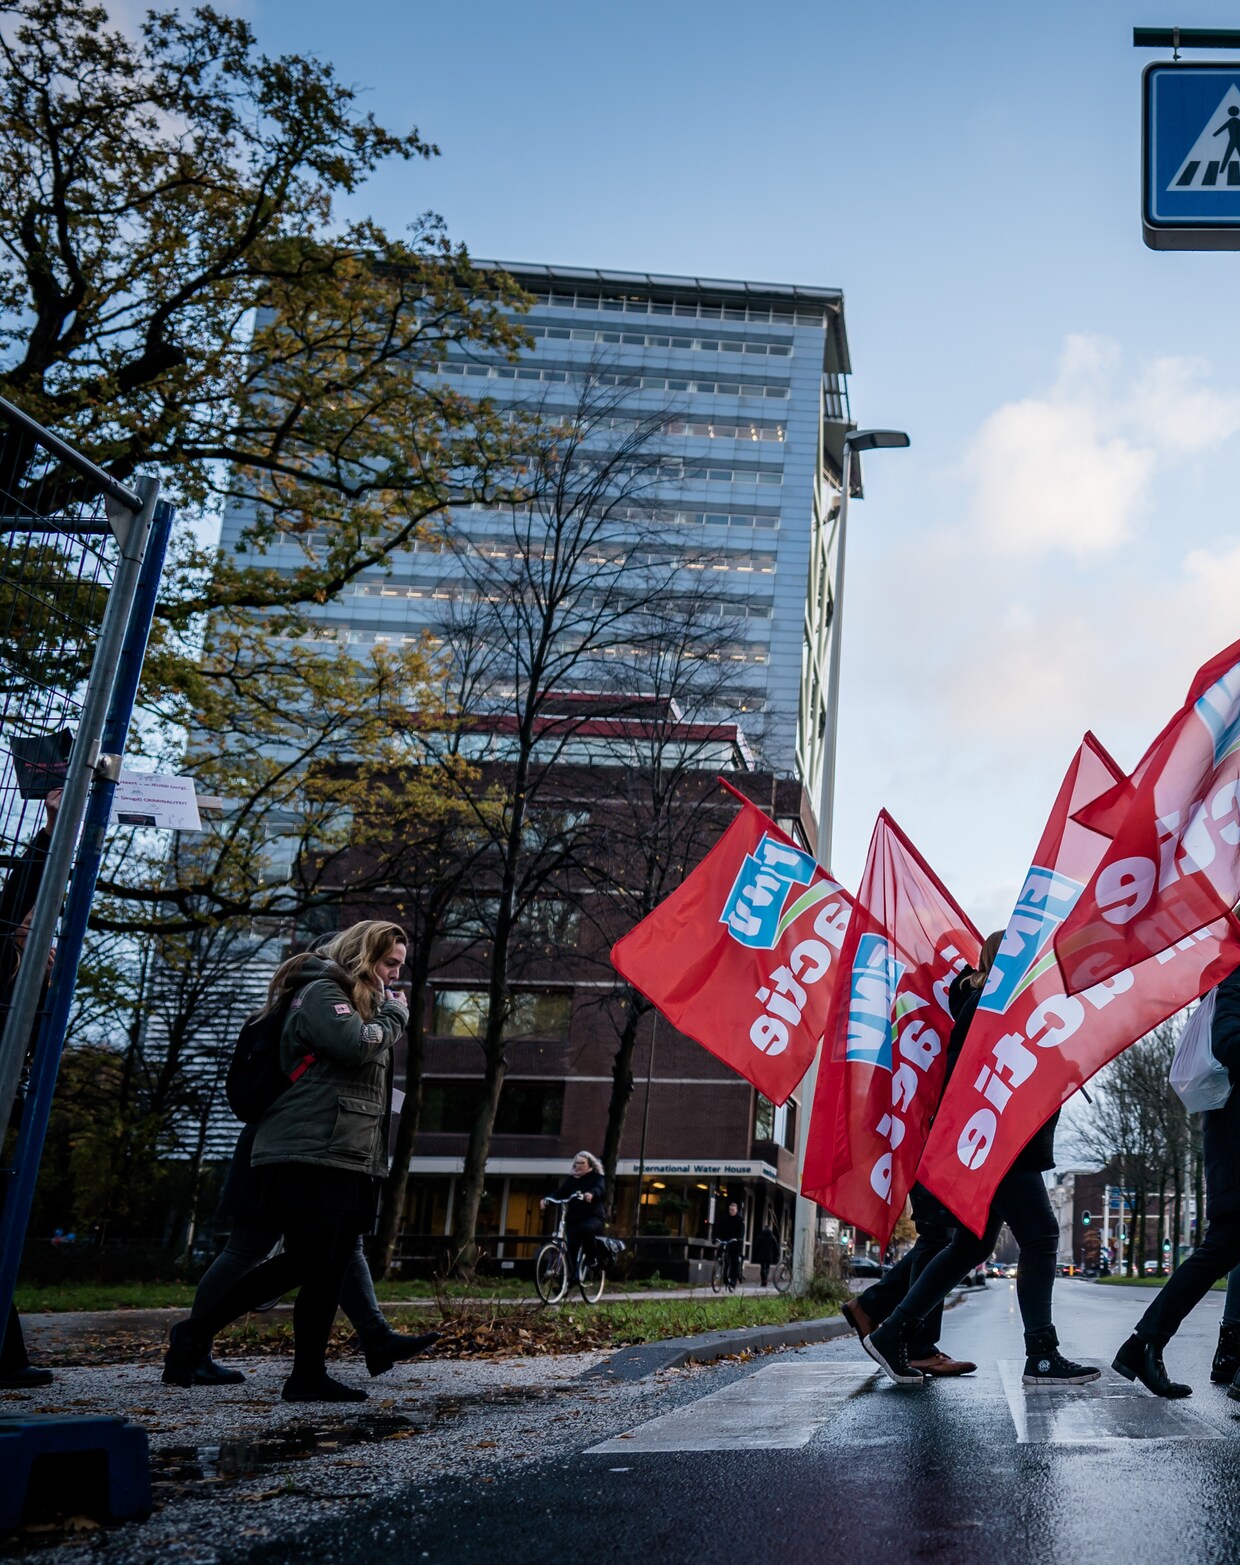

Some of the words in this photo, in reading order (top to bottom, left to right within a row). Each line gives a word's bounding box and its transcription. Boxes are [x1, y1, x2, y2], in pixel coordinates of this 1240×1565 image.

[143, 797, 188, 805] CRIMINALITEIT
[693, 1164, 721, 1173] Water
[724, 1164, 752, 1174] House
